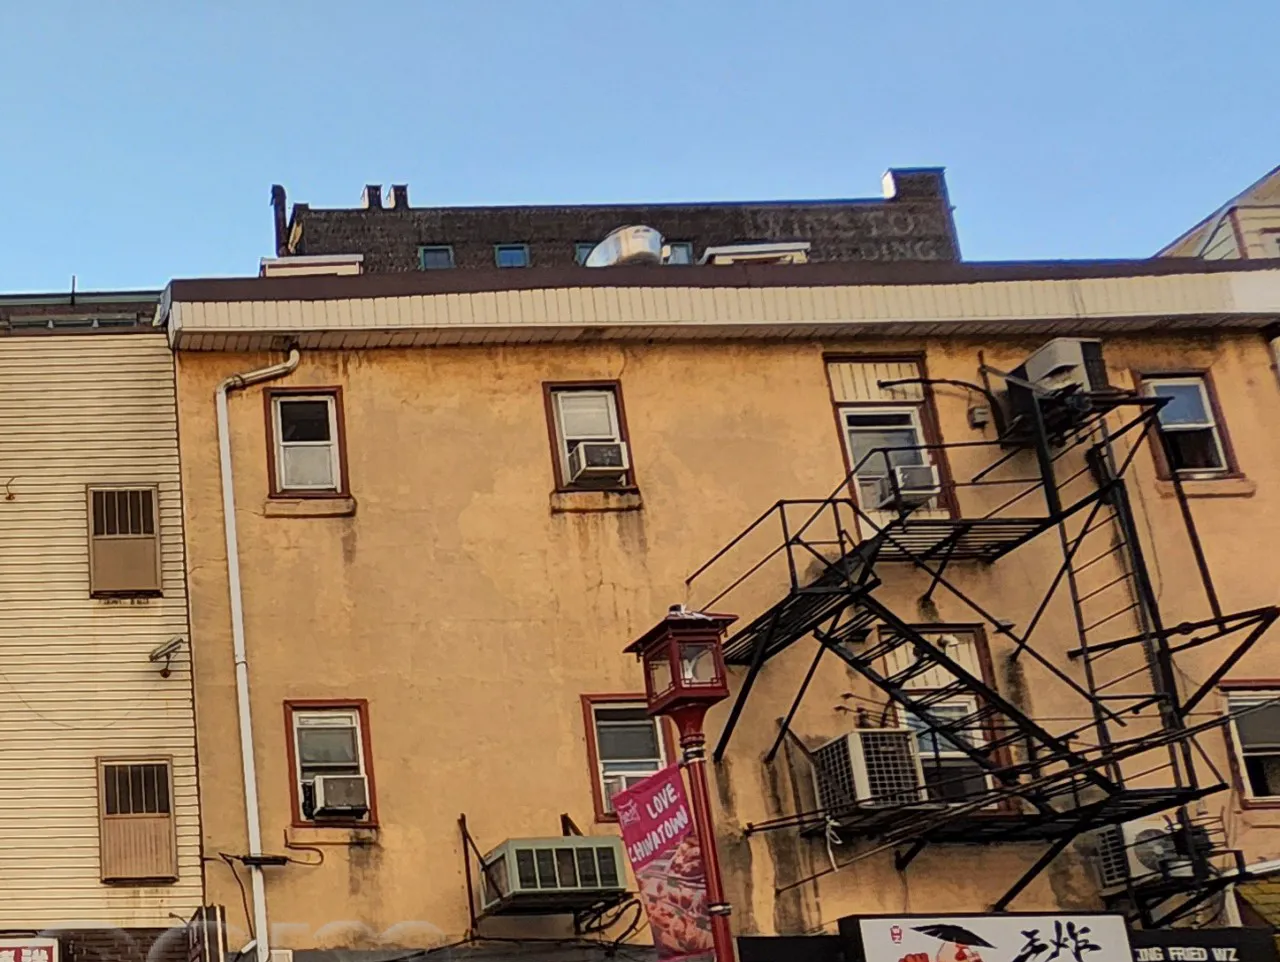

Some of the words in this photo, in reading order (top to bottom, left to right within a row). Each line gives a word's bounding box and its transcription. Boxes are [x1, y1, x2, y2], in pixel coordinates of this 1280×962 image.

[628, 804, 689, 862] CHINATOWN
[1134, 947, 1165, 962] ING
[1167, 946, 1209, 962] FRIED
[1211, 946, 1241, 962] WZ
